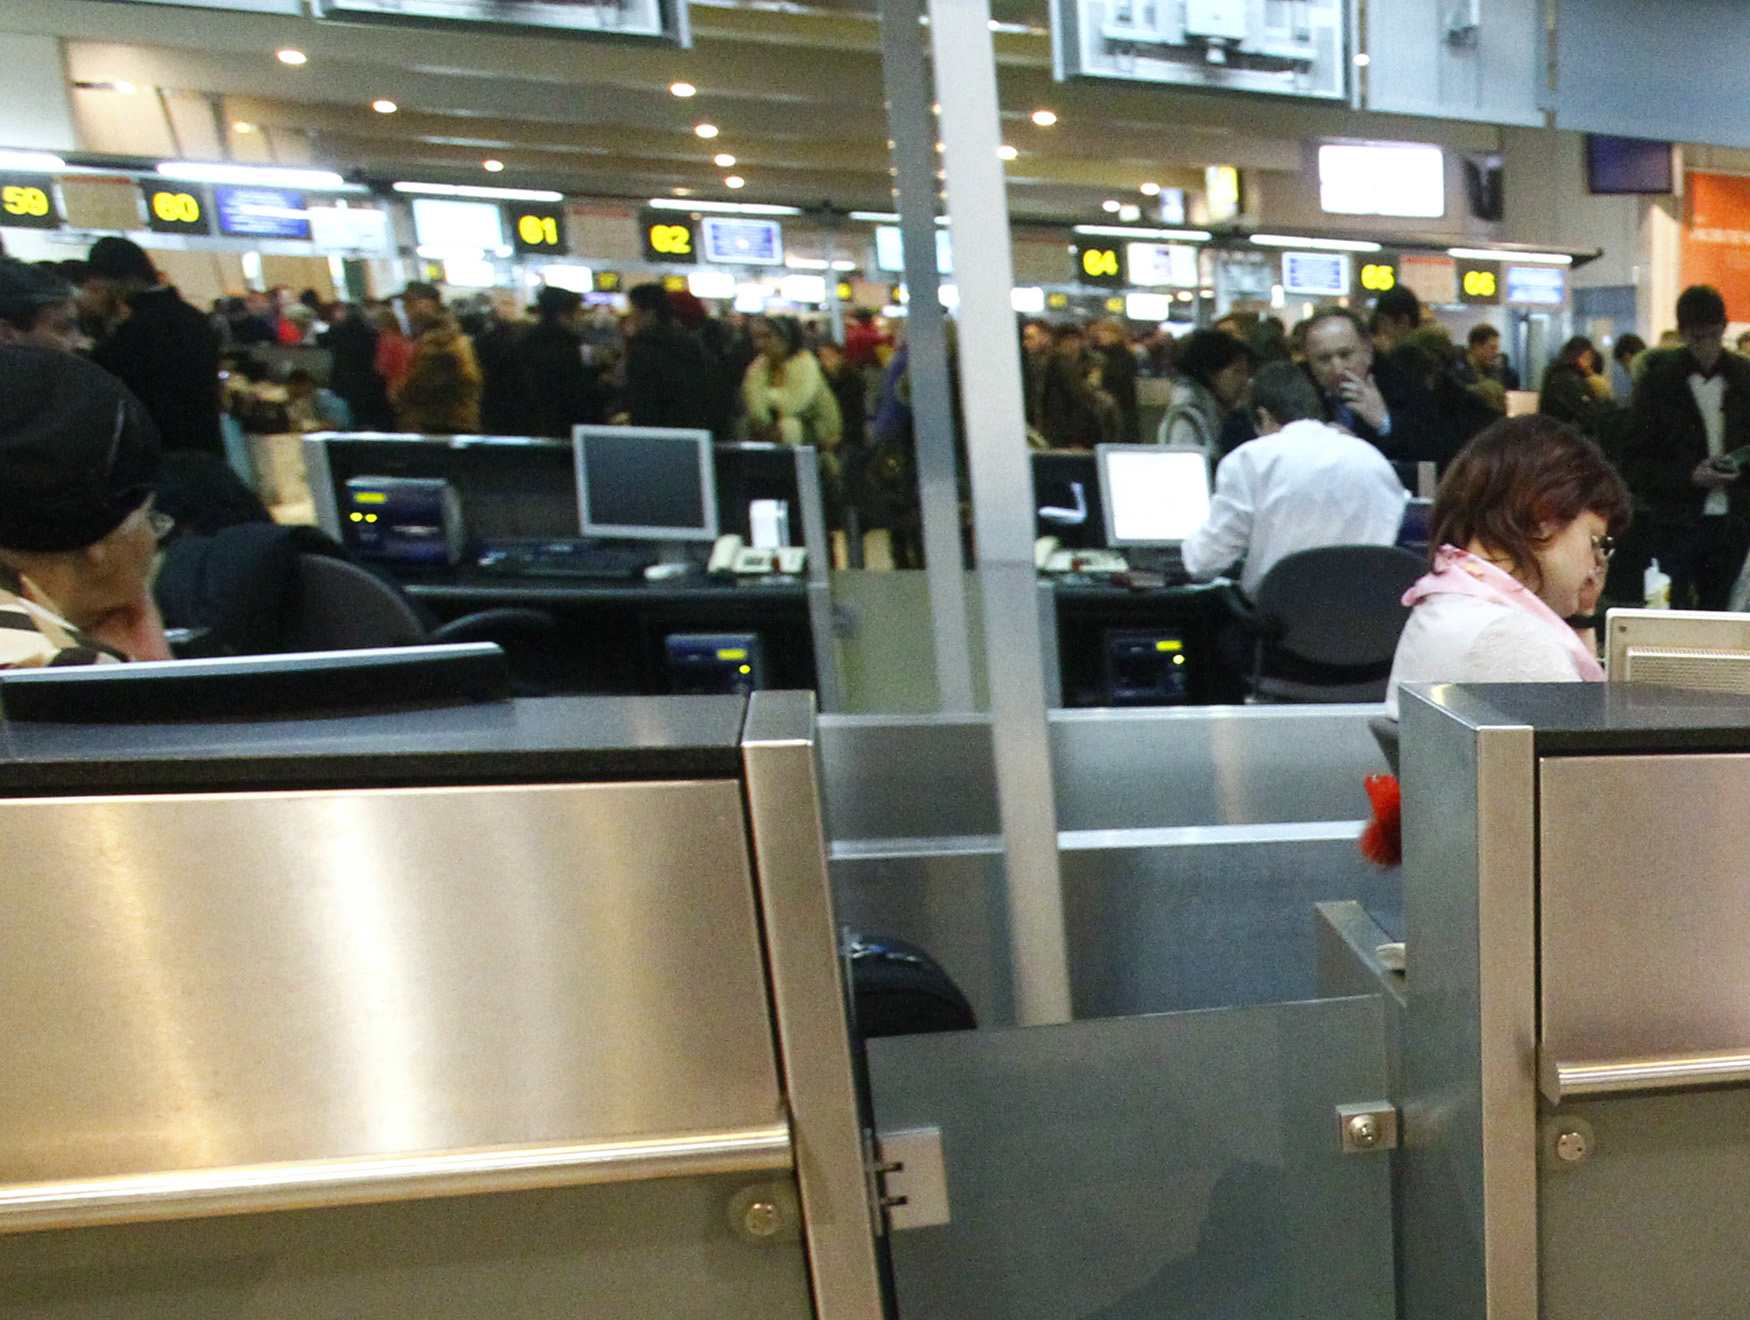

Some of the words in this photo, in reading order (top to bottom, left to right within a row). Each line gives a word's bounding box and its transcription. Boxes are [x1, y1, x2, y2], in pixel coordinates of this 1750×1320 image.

[2, 185, 49, 217] 59
[152, 192, 200, 223] 60
[518, 214, 558, 245] 61
[650, 224, 692, 254] 62
[1082, 249, 1118, 277] 64
